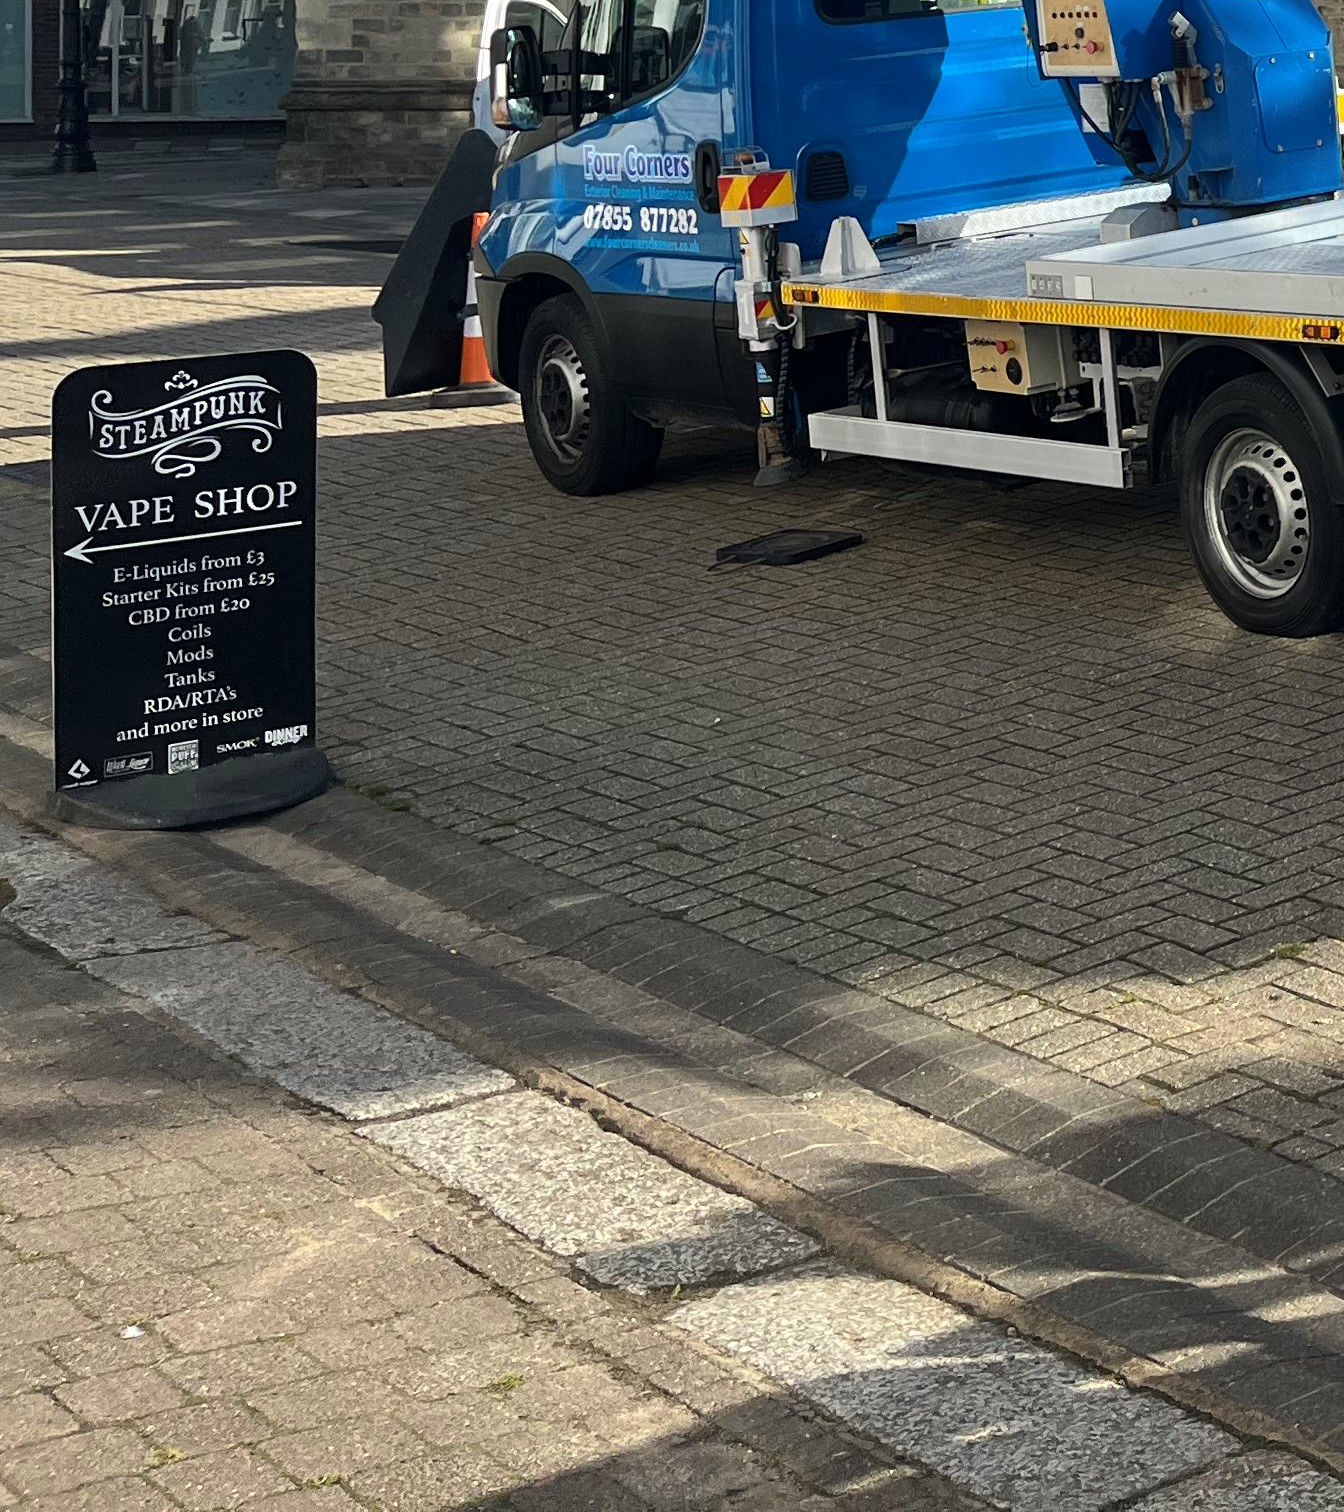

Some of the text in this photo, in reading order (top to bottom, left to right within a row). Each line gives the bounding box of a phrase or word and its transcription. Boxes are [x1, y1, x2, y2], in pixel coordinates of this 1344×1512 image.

[583, 145, 693, 183] Four Corners
[648, 186, 696, 201] Maintenance
[584, 204, 698, 234] 07855 877282
[99, 390, 266, 450] STEAMPUNK
[74, 481, 297, 532] VAPE SHOP
[113, 549, 265, 583] E-Liquids from £3
[102, 571, 275, 607] Starter Kits from £25
[128, 597, 250, 626] CBD from £20
[168, 623, 212, 642] Coils
[166, 645, 214, 665] Mods
[164, 668, 215, 688] Tanks
[143, 686, 237, 715] RDA/RTA's
[116, 706, 264, 742] and more in store
